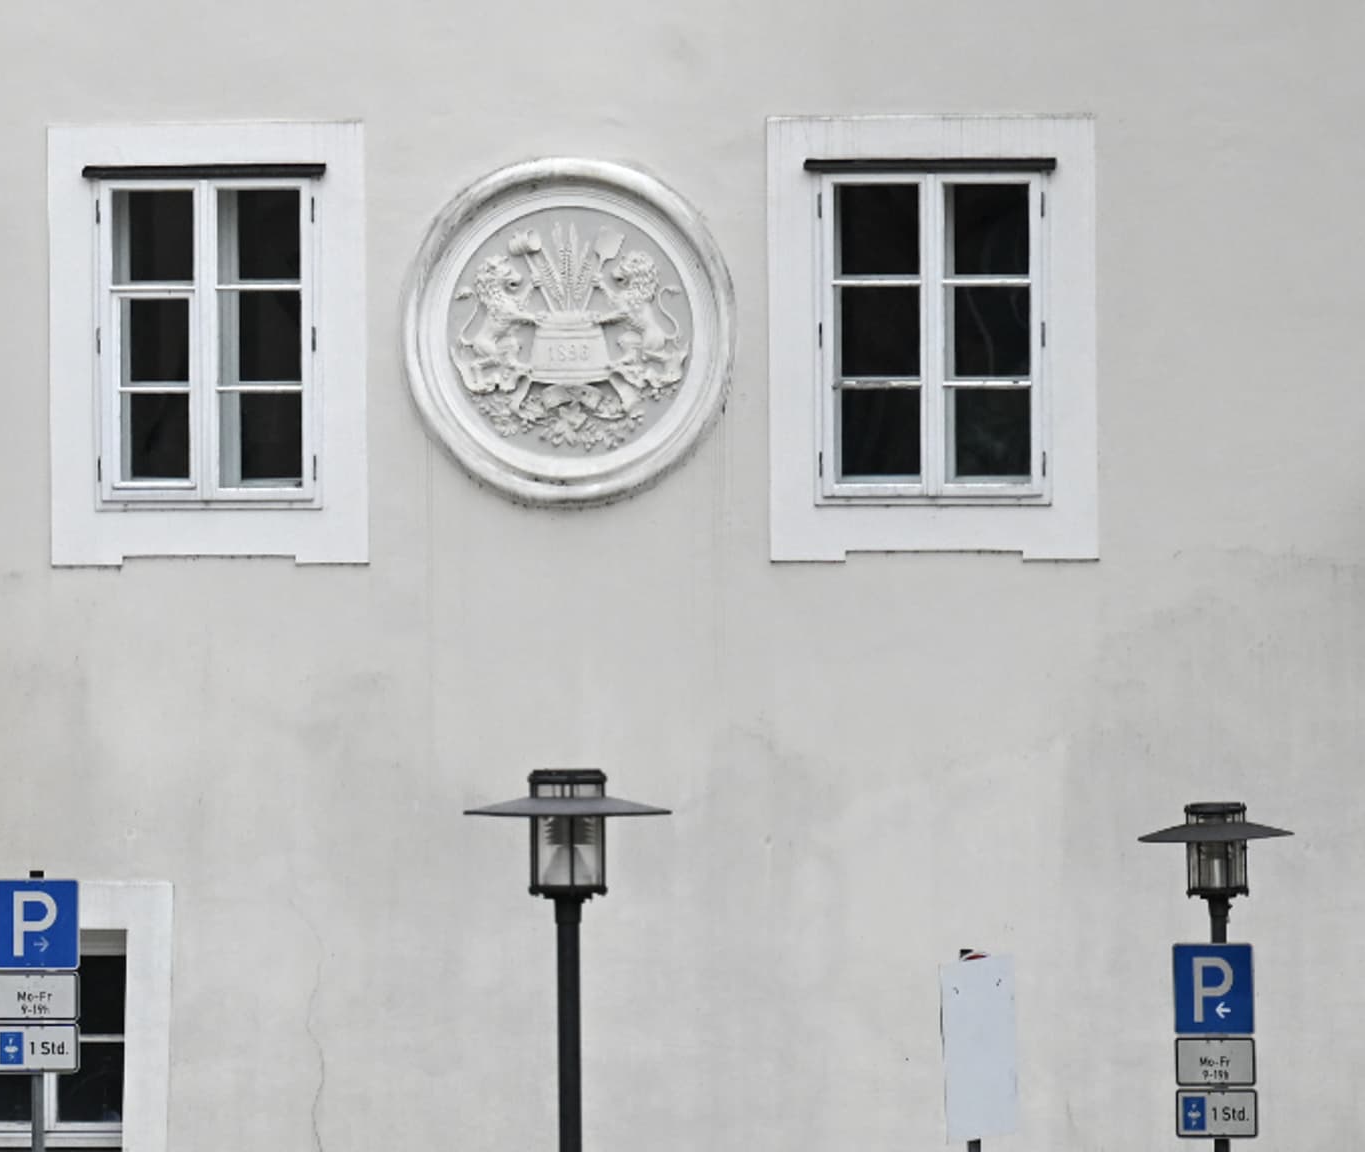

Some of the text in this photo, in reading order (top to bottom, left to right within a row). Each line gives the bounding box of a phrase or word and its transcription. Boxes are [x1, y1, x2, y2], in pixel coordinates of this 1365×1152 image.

[13, 890, 58, 957] P
[1192, 956, 1234, 1023] P
[40, 1041, 69, 1056] Std.
[1221, 1107, 1250, 1122] Std.
